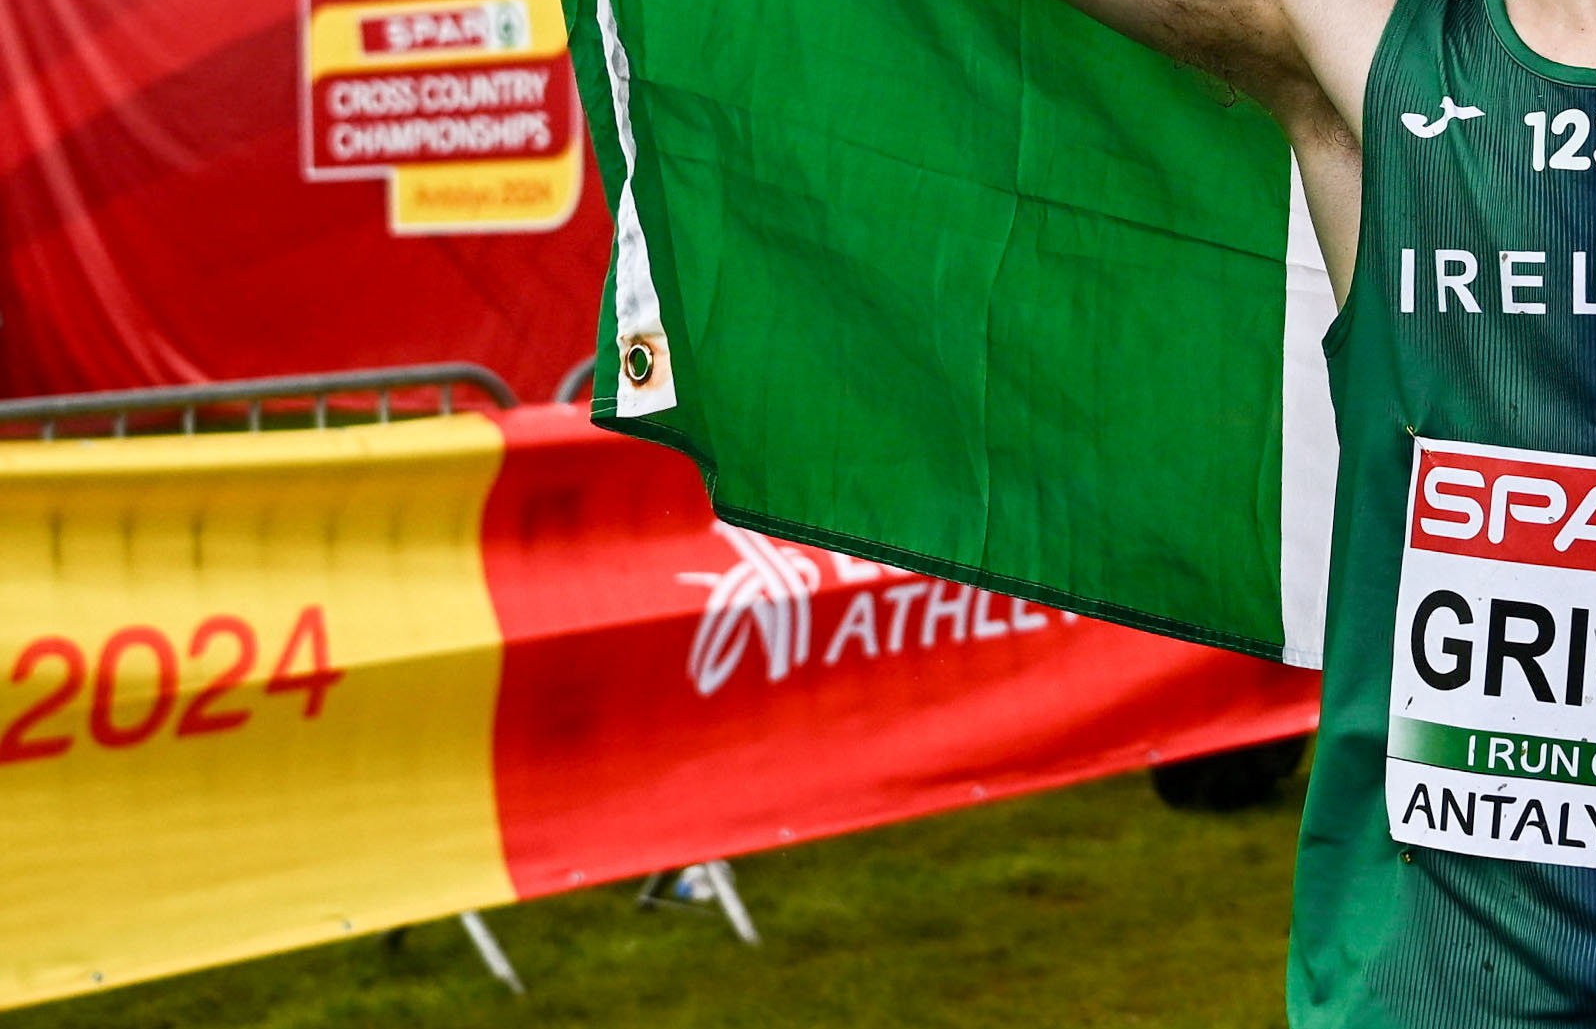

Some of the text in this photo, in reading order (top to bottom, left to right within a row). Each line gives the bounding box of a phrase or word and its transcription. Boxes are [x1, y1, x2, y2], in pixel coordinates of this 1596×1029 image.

[386, 12, 486, 53] SPAR
[329, 68, 548, 116] CROSS COUNTRY
[330, 113, 551, 159] CHAMPIONSHIPS
[0, 604, 345, 765] 2024
[1467, 735, 1475, 767] I
[1487, 738, 1580, 779] RUN
